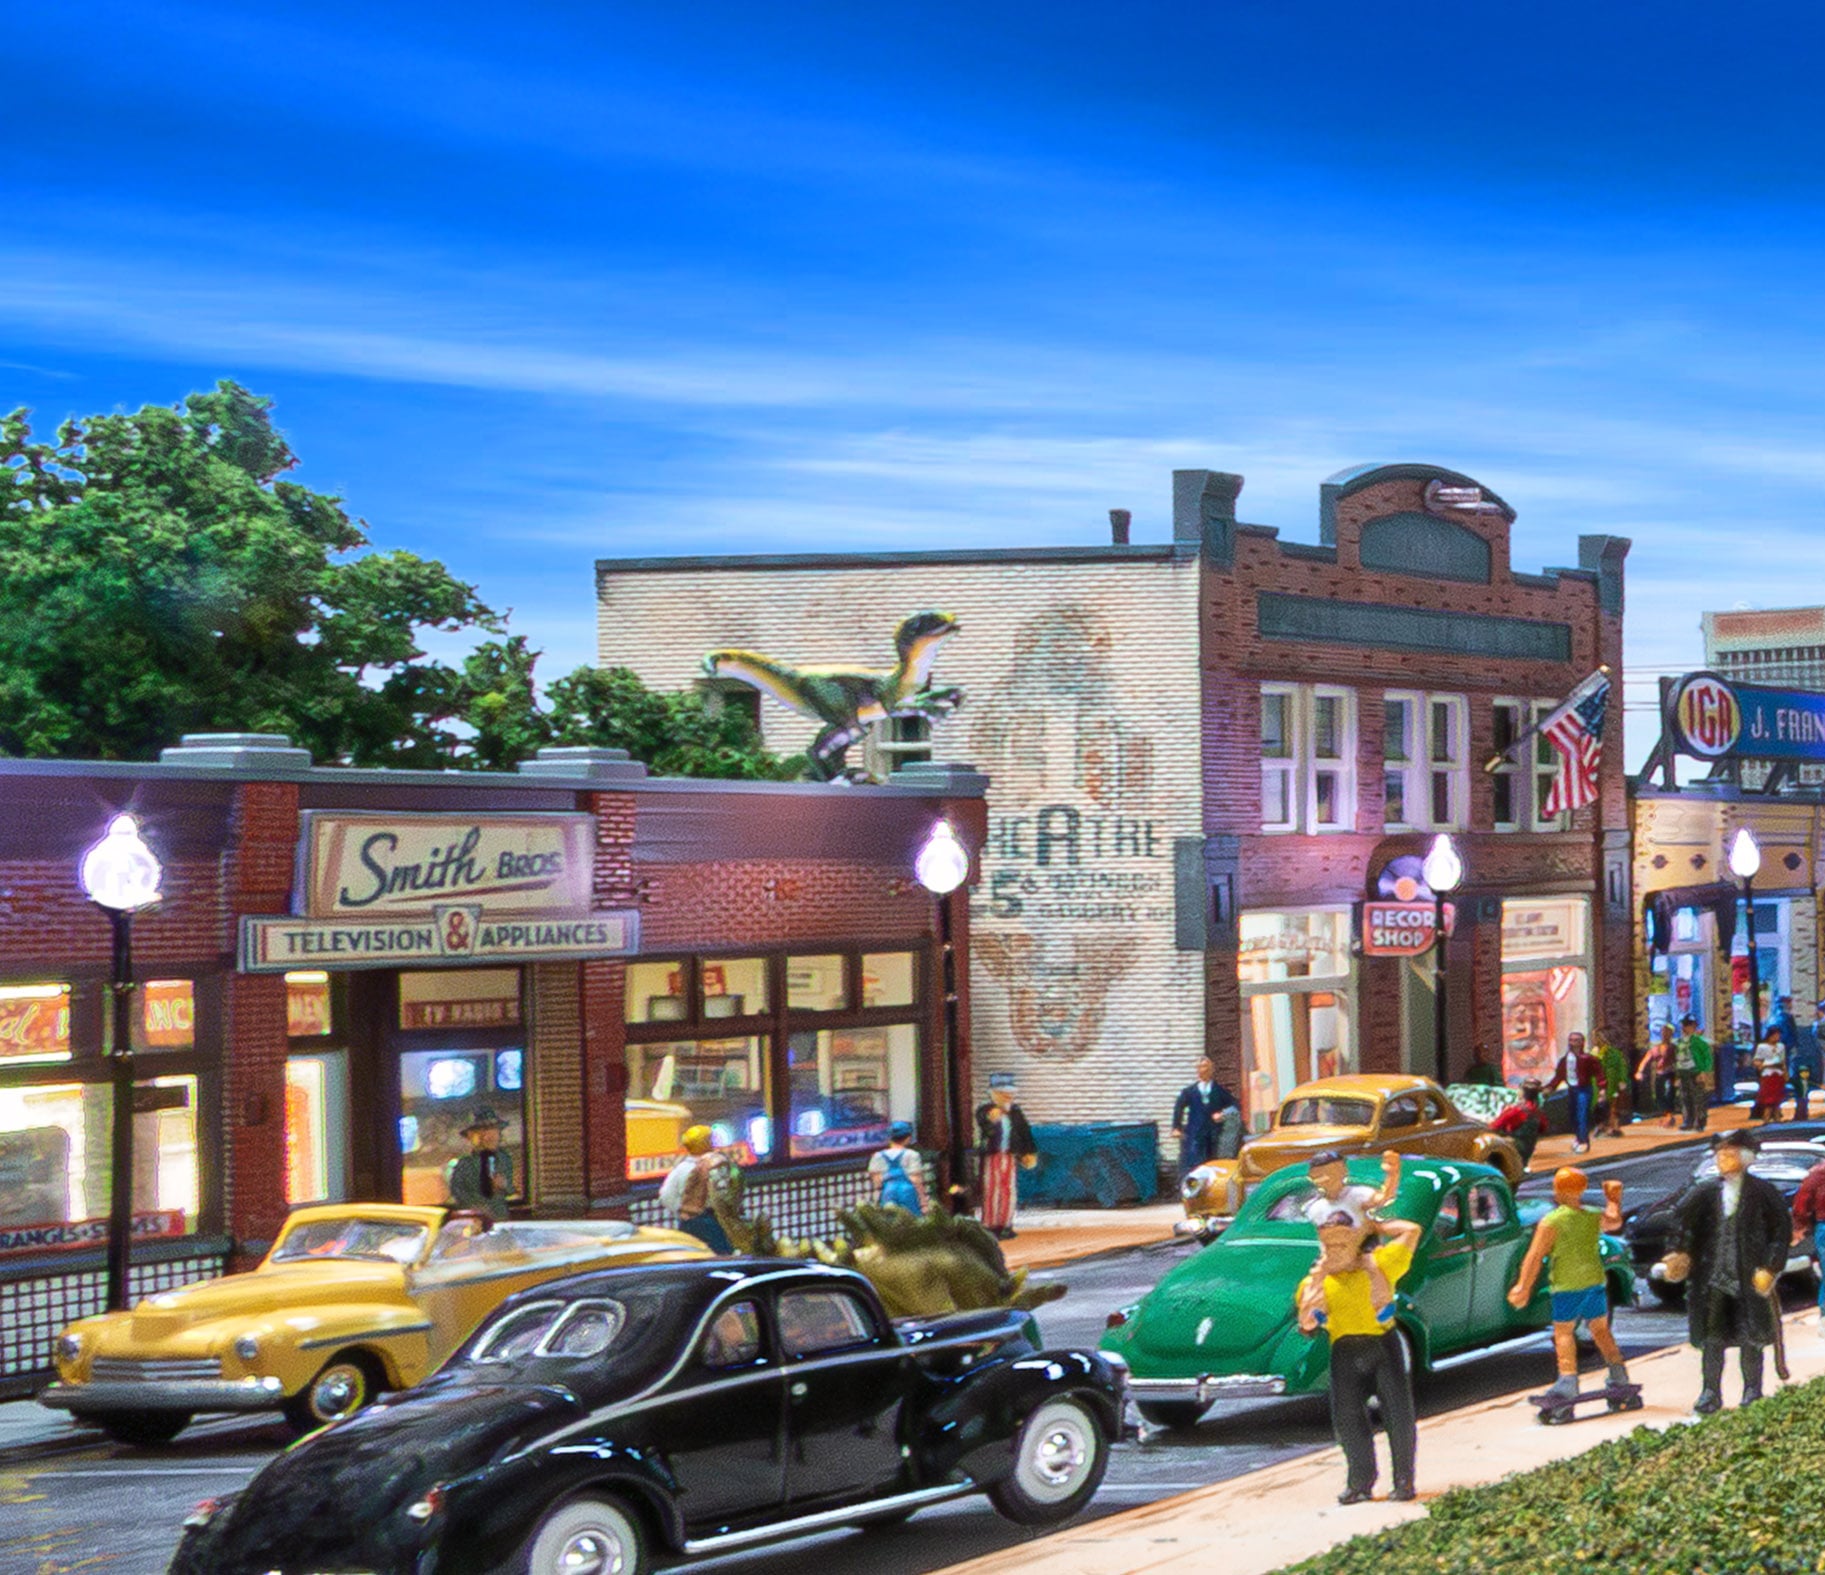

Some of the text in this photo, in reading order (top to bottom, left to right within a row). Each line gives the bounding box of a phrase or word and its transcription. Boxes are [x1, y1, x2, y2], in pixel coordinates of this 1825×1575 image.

[1687, 683, 1733, 748] IGA
[1750, 705, 1770, 739] J.
[339, 826, 486, 907] Smith
[284, 911, 609, 954] TELEVISION & APPLIANCES
[1371, 909, 1440, 928] RECOR
[1372, 929, 1426, 948] SHOP
